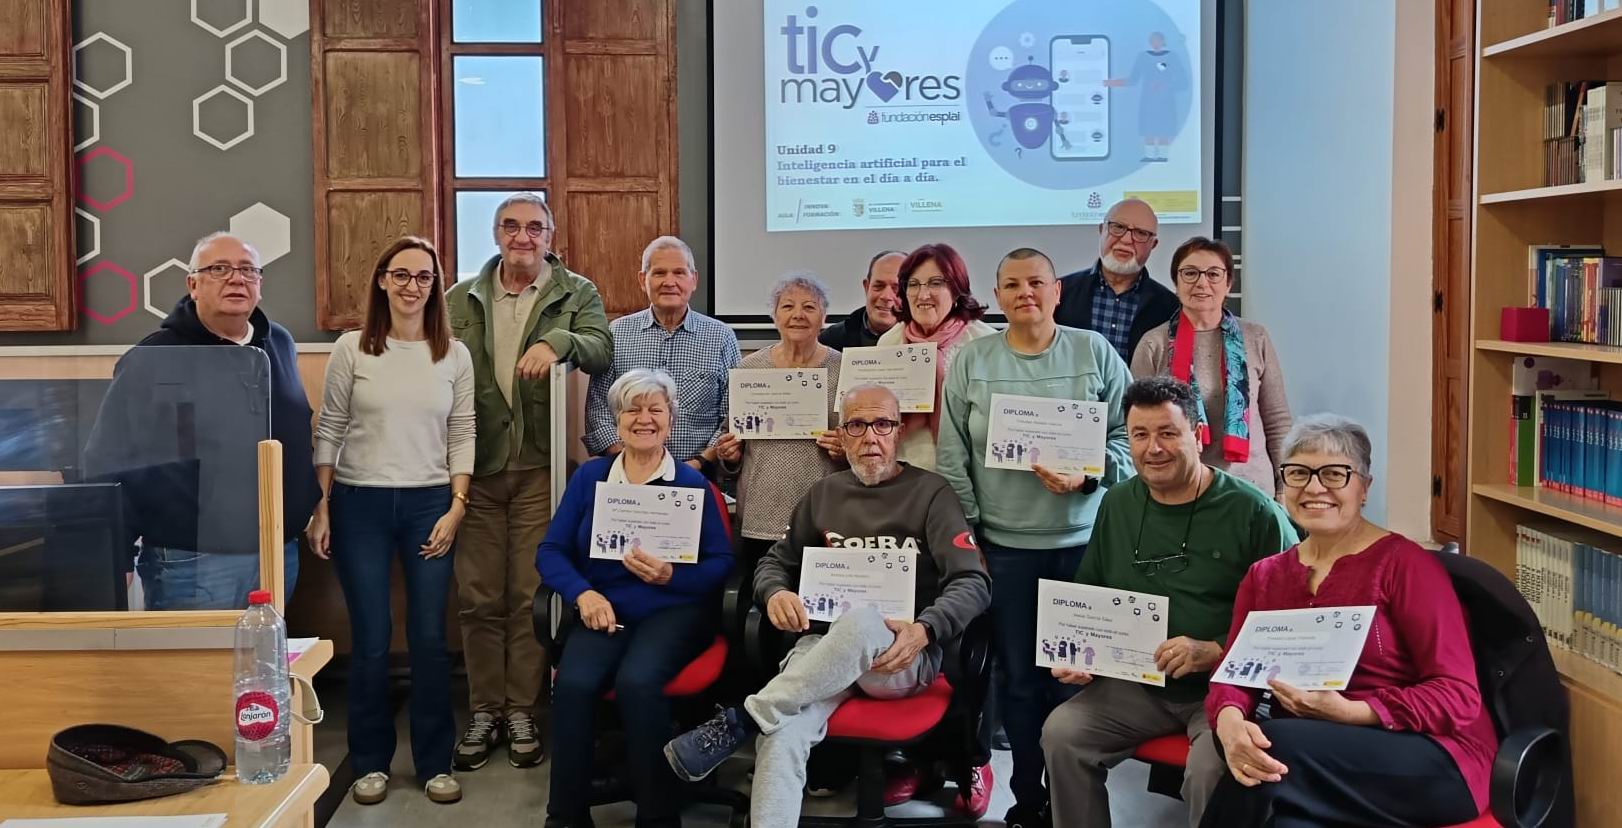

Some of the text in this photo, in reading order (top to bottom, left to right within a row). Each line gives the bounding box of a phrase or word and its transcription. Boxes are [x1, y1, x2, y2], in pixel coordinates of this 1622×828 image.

[777, 144, 837, 156] Unidad 9
[777, 156, 967, 172] Inteligencia artificial para el
[777, 175, 839, 187] bienestar
[843, 176, 860, 185] en
[863, 174, 876, 185] el
[879, 173, 899, 184] día
[903, 175, 911, 183] a
[1003, 408, 1034, 417] DIPLOMA
[607, 497, 636, 506] DIPLOMA
[815, 562, 846, 570] DIPLOMA
[1052, 598, 1087, 609] DIPLOMA
[1254, 625, 1289, 633] DIPLOMA
